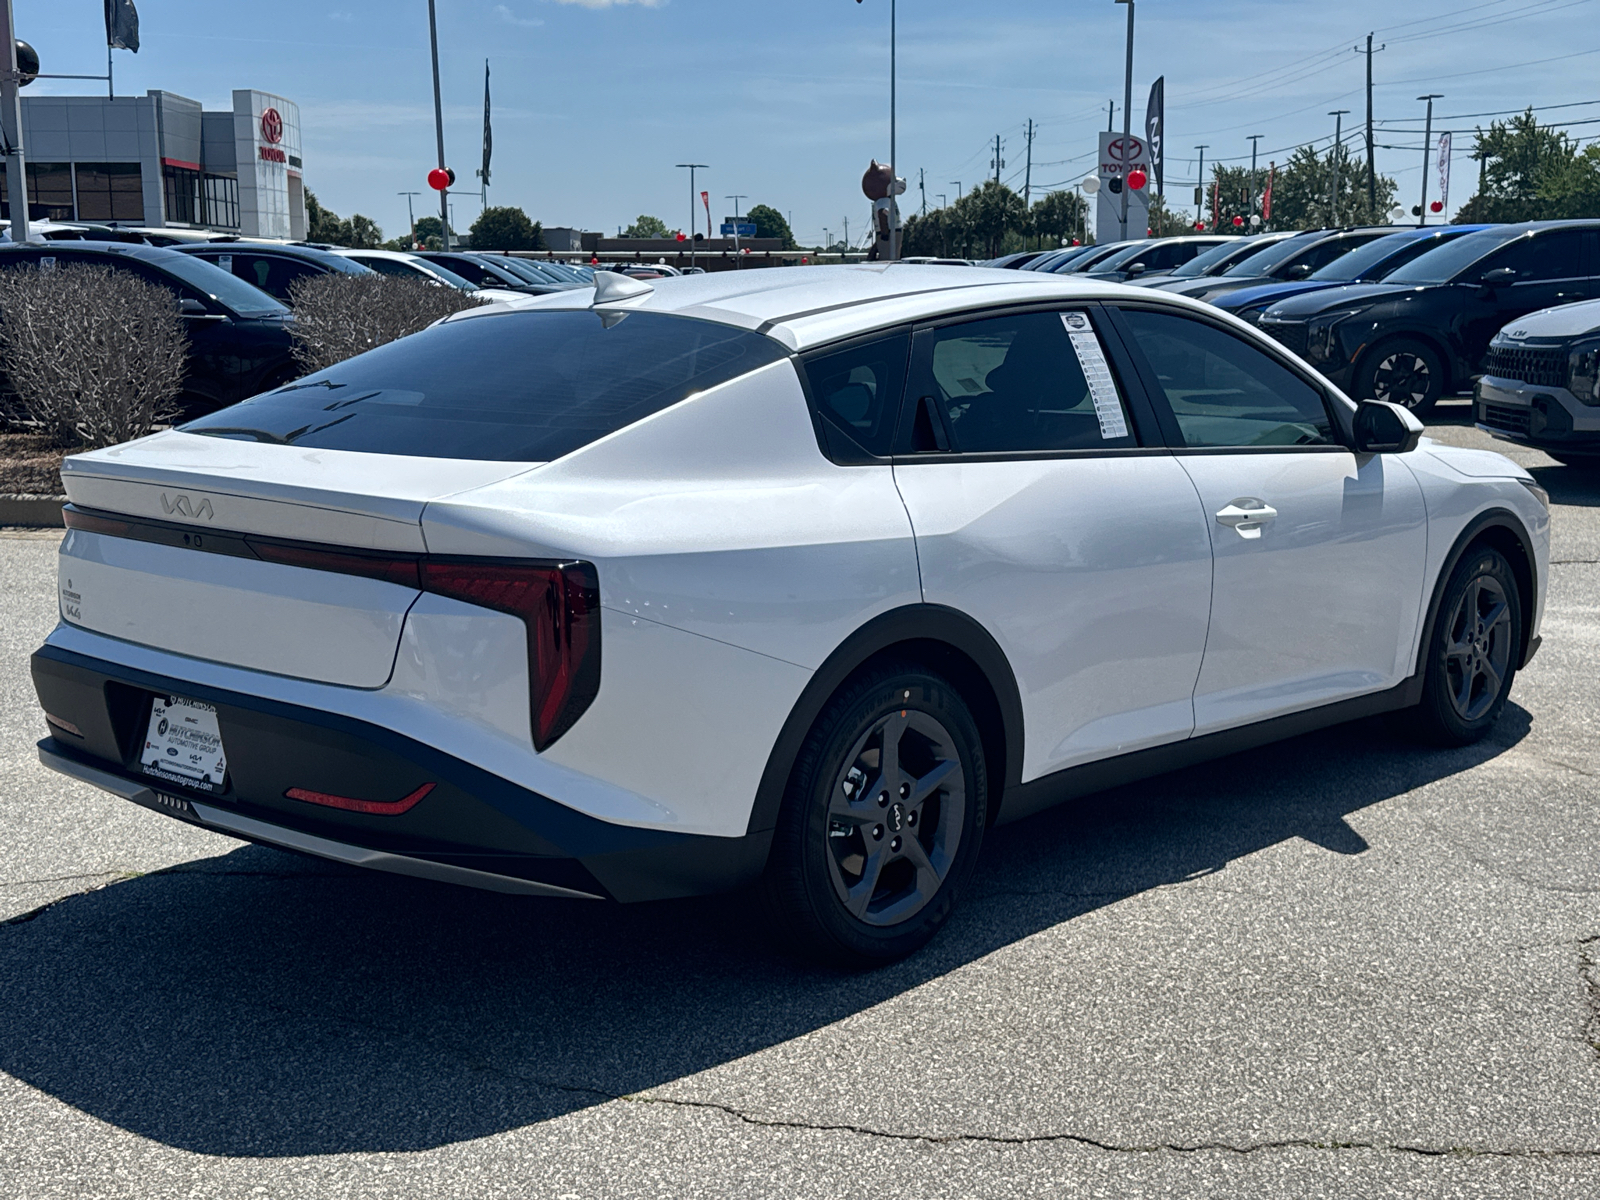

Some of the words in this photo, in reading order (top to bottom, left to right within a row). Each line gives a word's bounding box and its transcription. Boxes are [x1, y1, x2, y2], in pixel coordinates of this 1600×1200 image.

[260, 147, 286, 163] TOYOTA
[160, 493, 214, 520] KIA
[167, 736, 198, 751] AUTOMOTIVE
[199, 743, 217, 755] GROUP
[168, 724, 220, 748] HUTCHINSON
[972, 745, 985, 827] KUMHO
